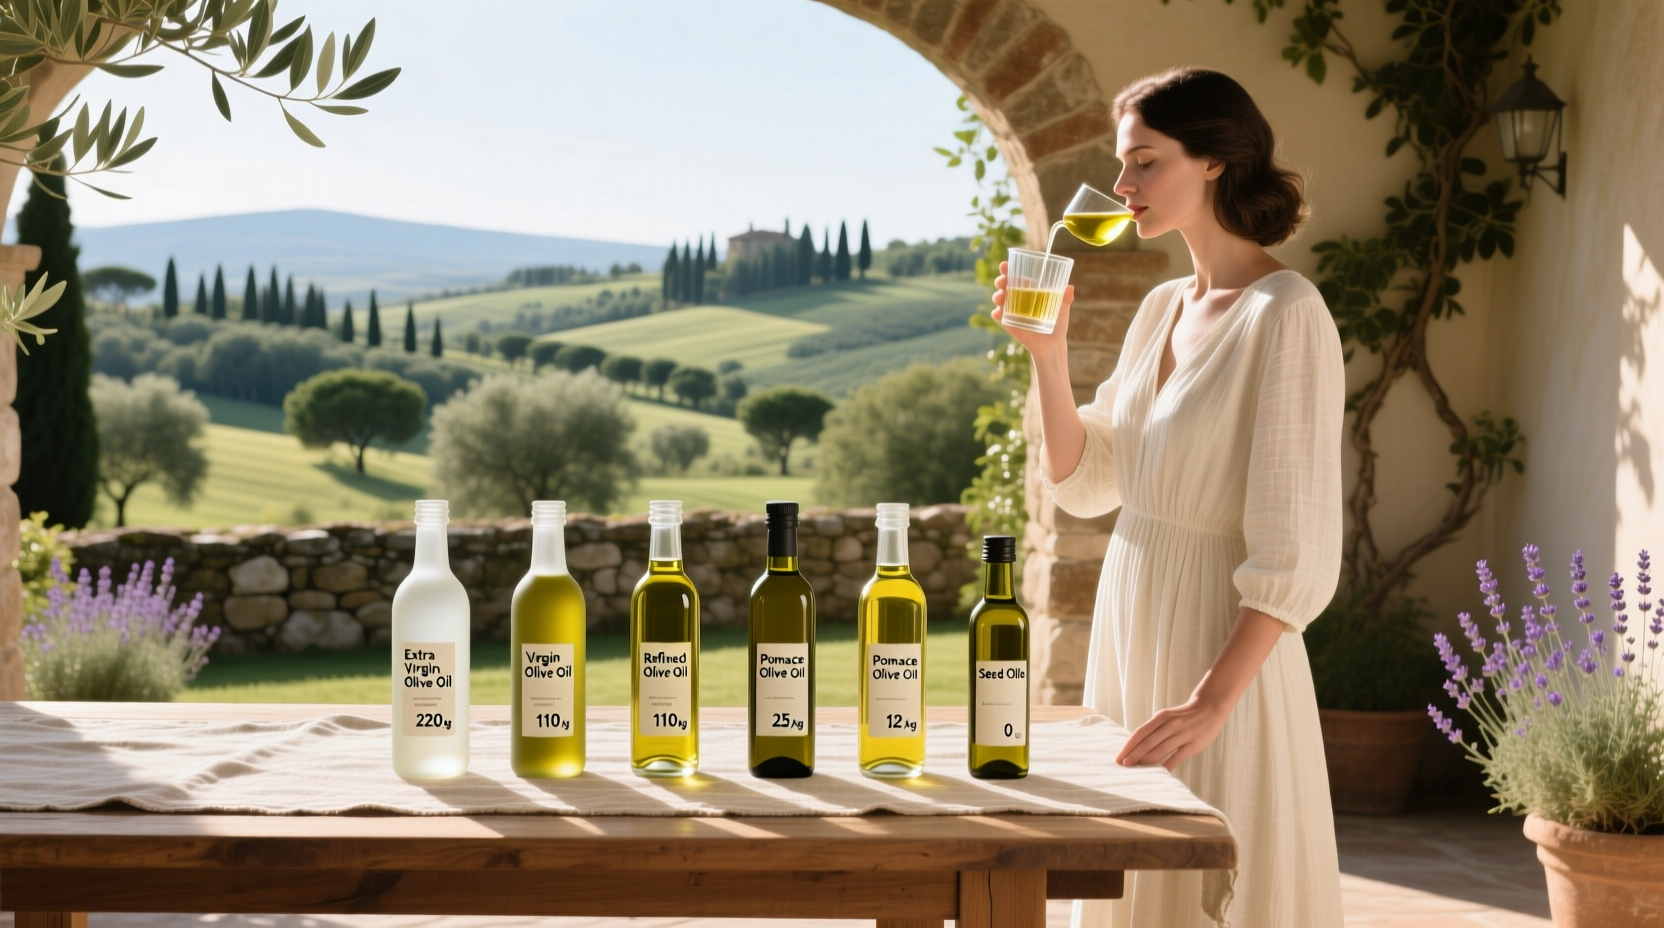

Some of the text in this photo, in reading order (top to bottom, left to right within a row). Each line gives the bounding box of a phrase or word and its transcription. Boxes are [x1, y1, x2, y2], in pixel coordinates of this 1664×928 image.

[405, 649, 435, 660] Extra
[761, 654, 804, 664] Pomace
[873, 655, 917, 666] Pomace
[557, 665, 571, 677] Oil
[644, 666, 670, 677] Olive
[760, 667, 787, 678] Olive
[873, 668, 900, 680] Olive
[979, 668, 1003, 679] Seed
[436, 675, 452, 688] Oil
